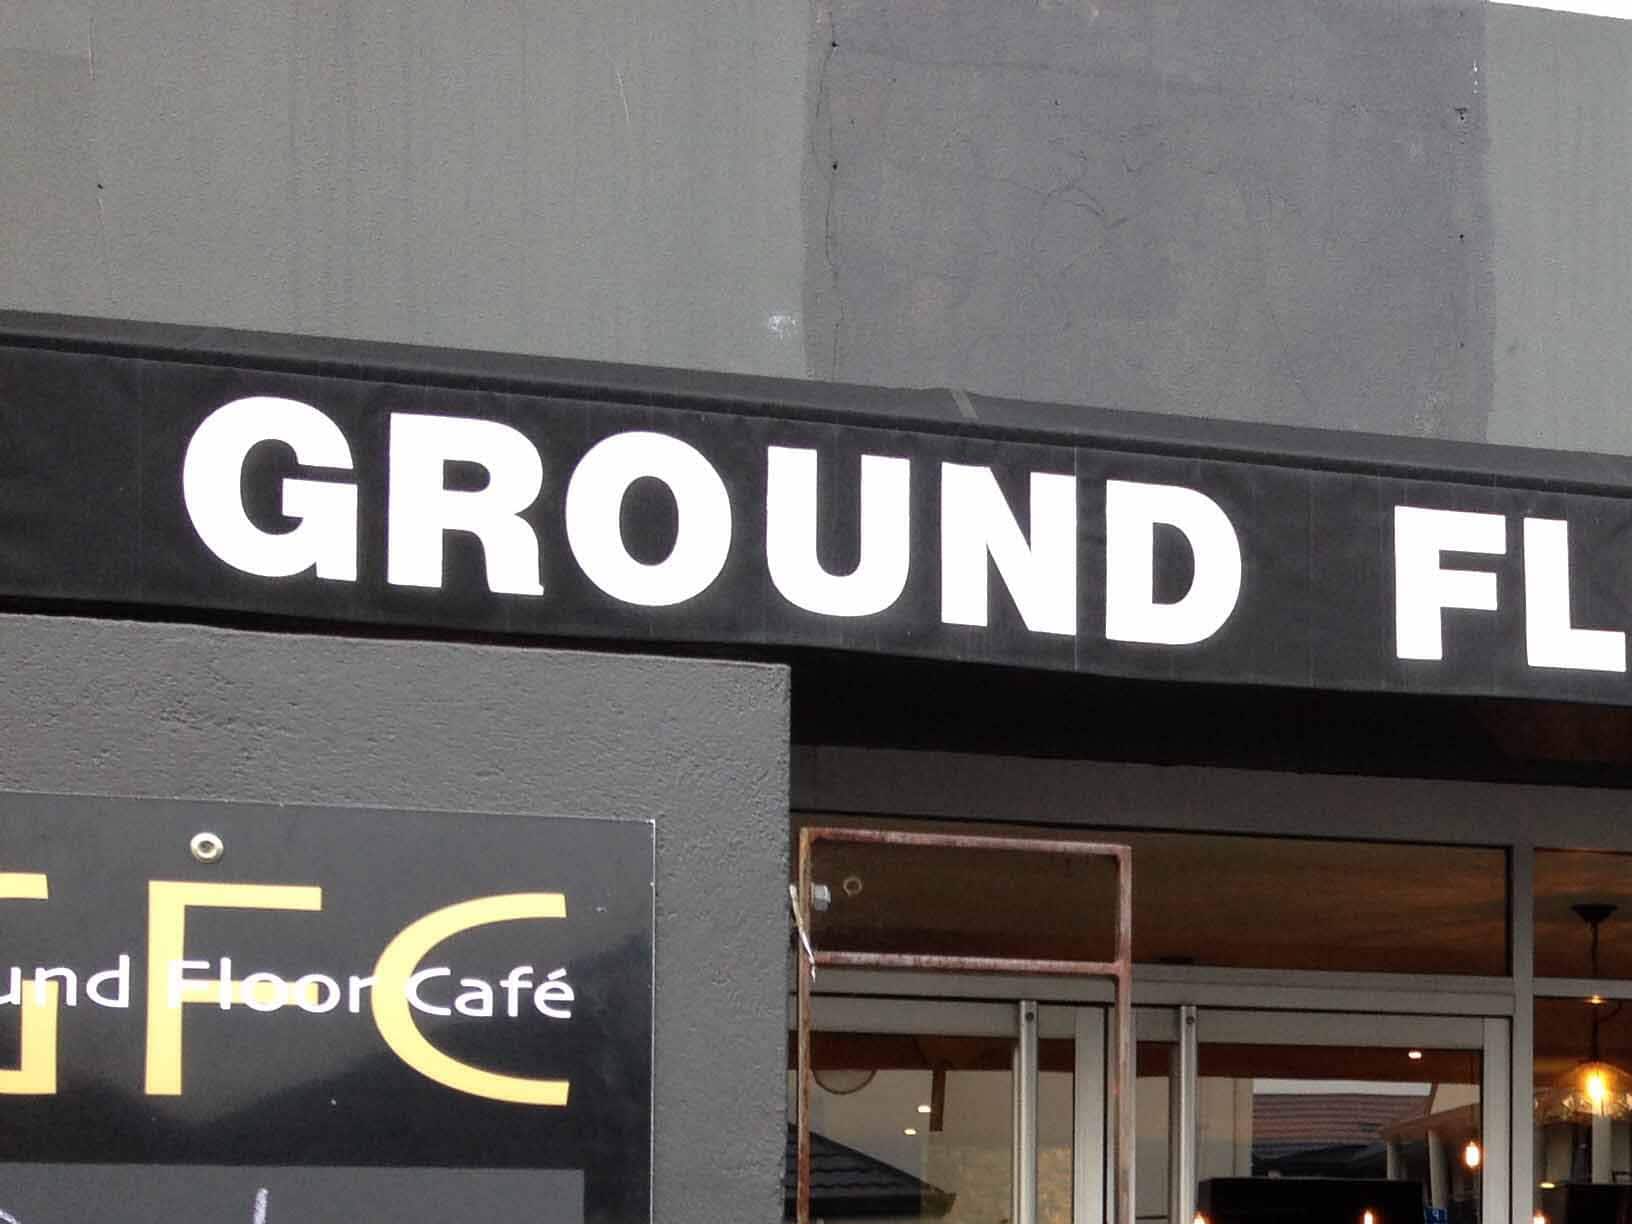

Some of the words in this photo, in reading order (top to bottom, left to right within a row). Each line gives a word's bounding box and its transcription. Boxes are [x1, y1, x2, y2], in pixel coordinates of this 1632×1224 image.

[183, 396, 1242, 645] GROUND
[0, 872, 570, 1106] FC
[168, 957, 374, 1013] Floor
[405, 966, 575, 1019] Café
